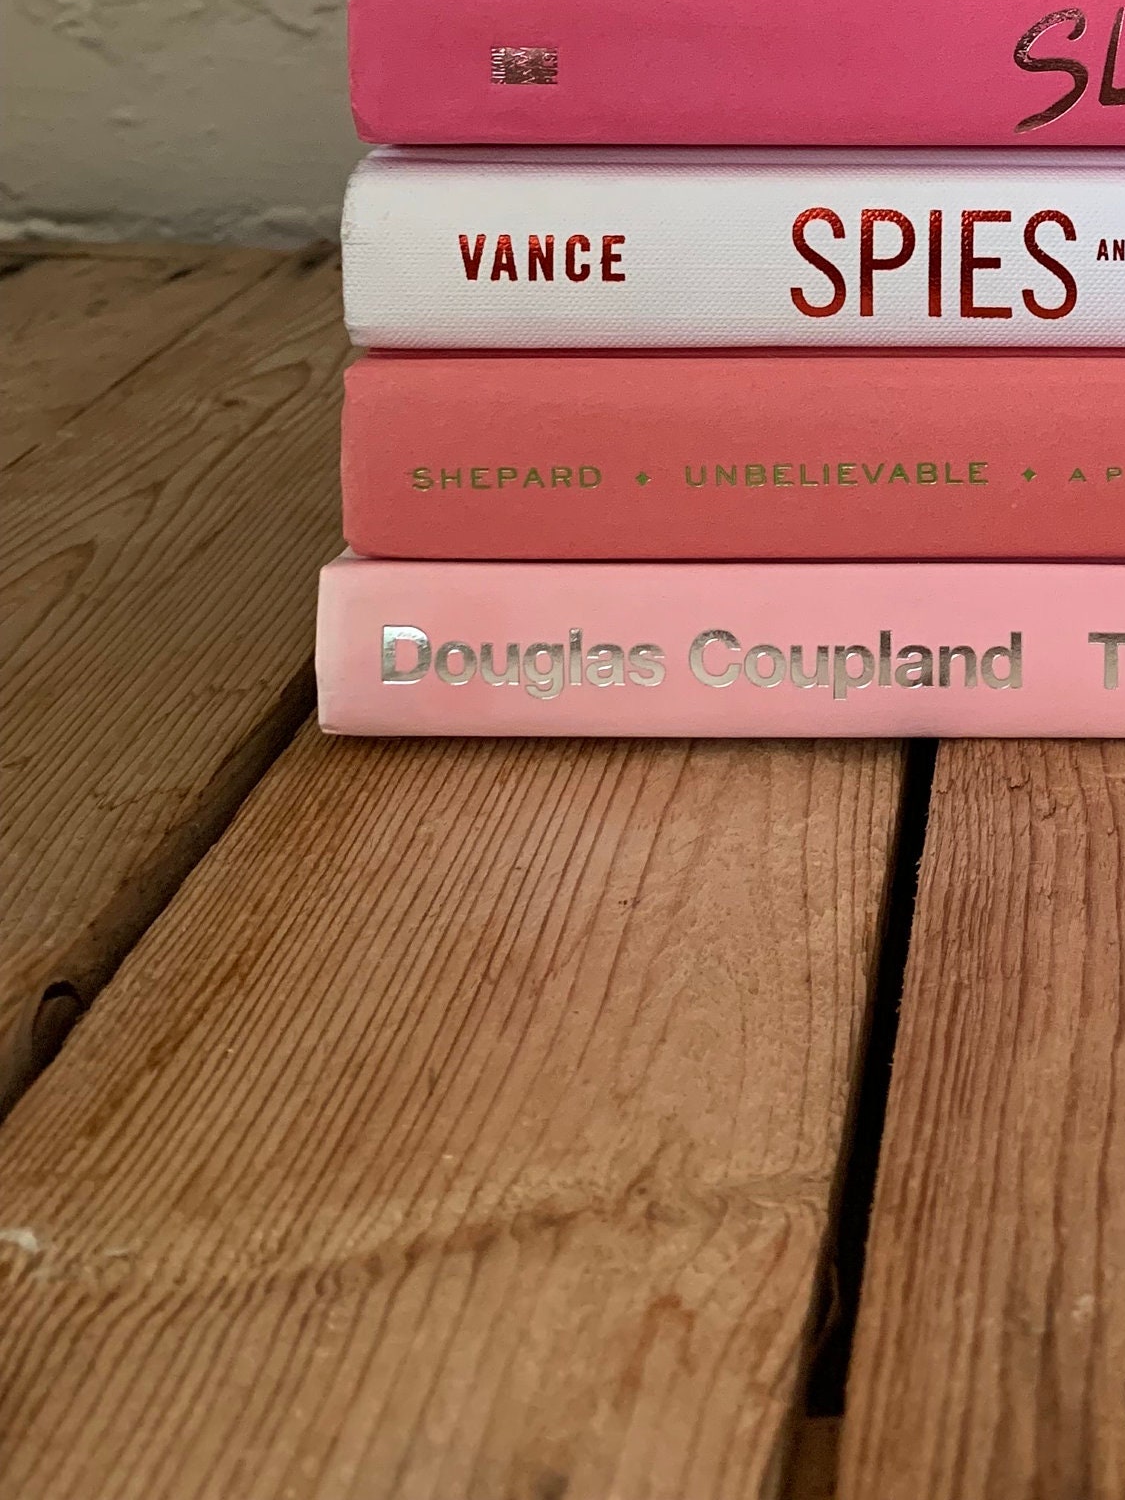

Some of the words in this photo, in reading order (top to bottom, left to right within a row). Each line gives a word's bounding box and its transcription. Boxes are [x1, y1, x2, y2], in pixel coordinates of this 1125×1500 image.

[458, 233, 626, 283] VANCE
[790, 207, 1078, 320] SPIES
[411, 466, 603, 492] SHEPARD
[685, 462, 989, 488] UNBELIEVABLE
[1067, 467, 1088, 483] A
[381, 625, 667, 701] Douglas
[688, 628, 1023, 701] Coupland
